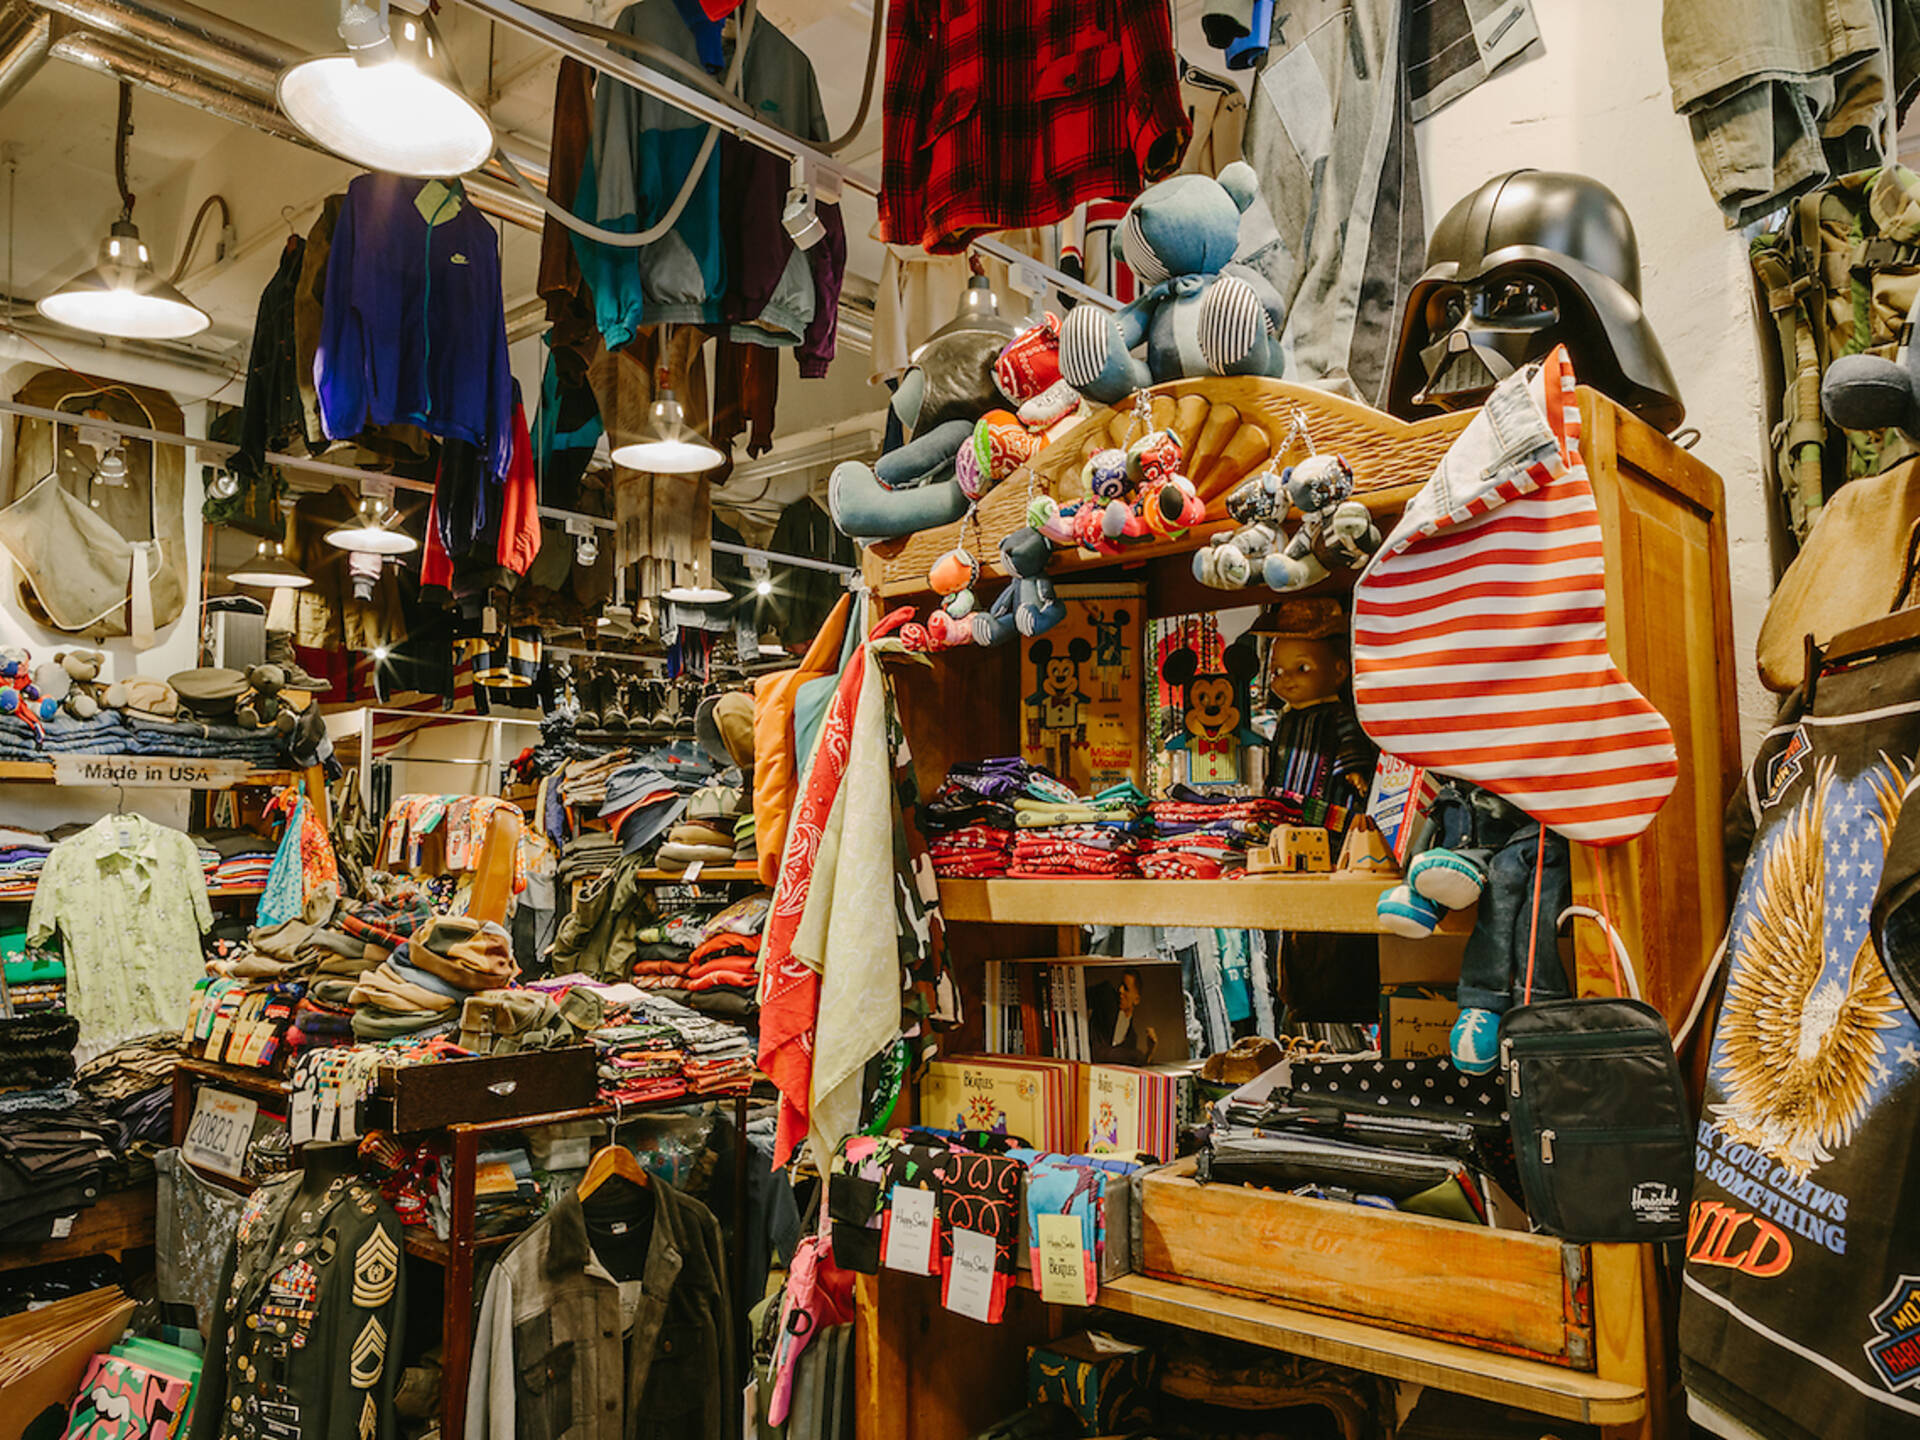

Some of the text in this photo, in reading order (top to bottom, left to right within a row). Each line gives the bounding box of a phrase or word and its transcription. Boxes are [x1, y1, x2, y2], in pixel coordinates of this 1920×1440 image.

[84, 764, 210, 782] Made in USA
[1705, 1159, 1848, 1255] SOMETHING
[1717, 1131, 1773, 1181] YOUR
[1768, 1166, 1849, 1222] CLAWS
